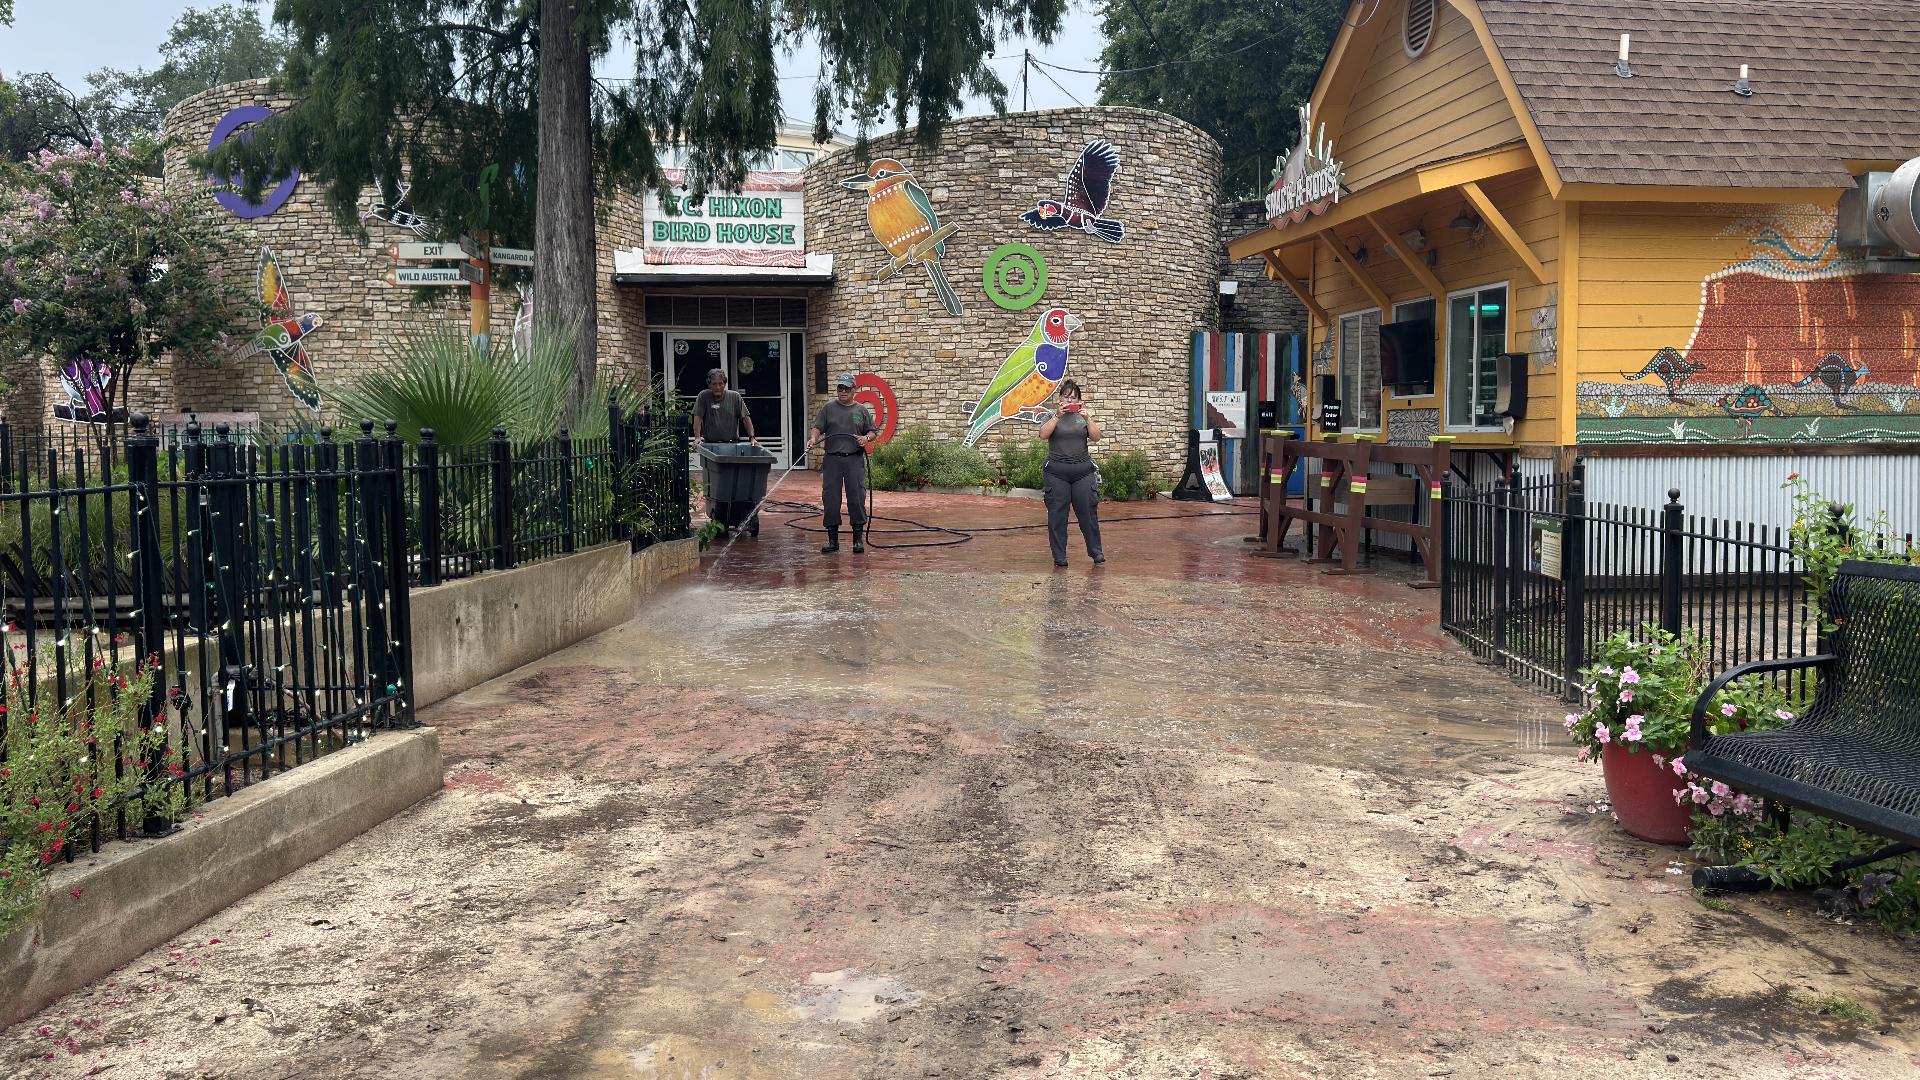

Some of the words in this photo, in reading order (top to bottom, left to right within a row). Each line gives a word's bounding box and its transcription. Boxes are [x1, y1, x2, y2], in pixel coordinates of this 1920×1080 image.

[709, 196, 782, 218] HIXON
[653, 221, 710, 242] BIRD
[717, 223, 795, 244] HOUSE
[423, 246, 443, 256] EXIT
[493, 252, 528, 262] KANGAROO
[399, 272, 420, 281] WILD
